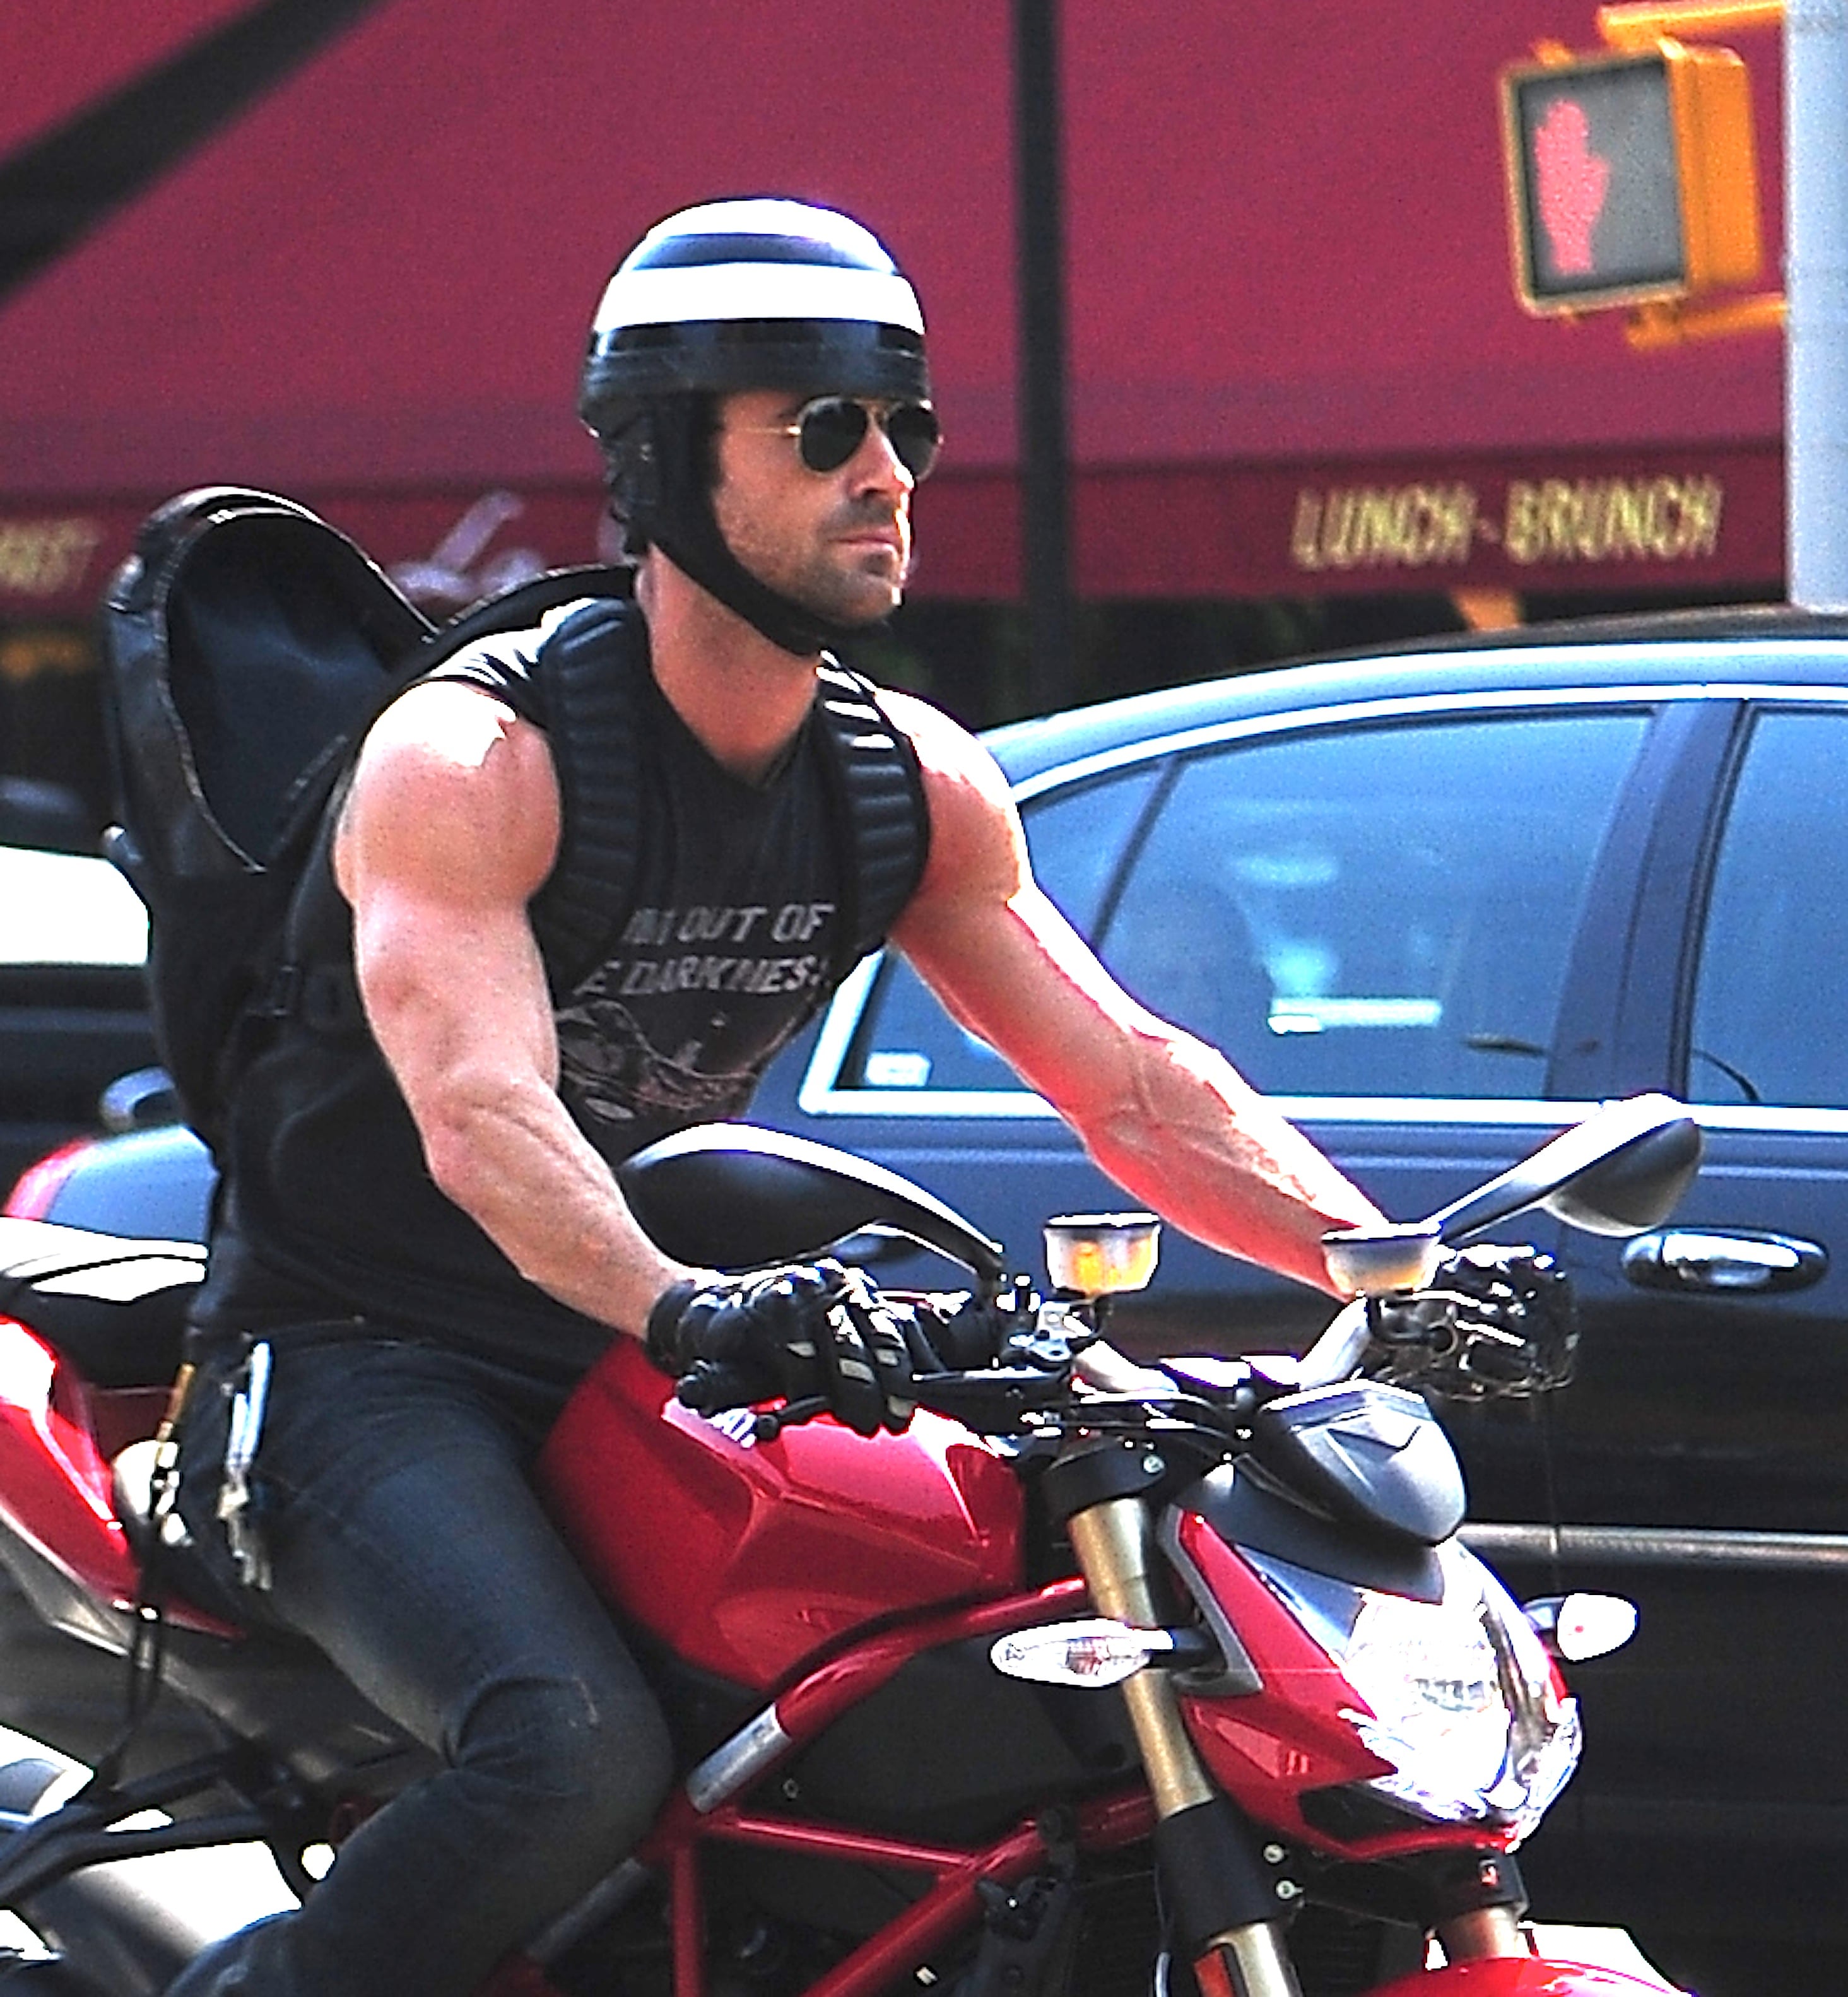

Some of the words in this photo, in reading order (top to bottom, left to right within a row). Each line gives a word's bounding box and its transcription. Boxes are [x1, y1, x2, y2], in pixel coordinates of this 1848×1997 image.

[1292, 482, 1478, 568] LUNCH
[1504, 474, 1722, 565] BRUNCH
[677, 904, 768, 944] OUT
[770, 903, 835, 943] OF
